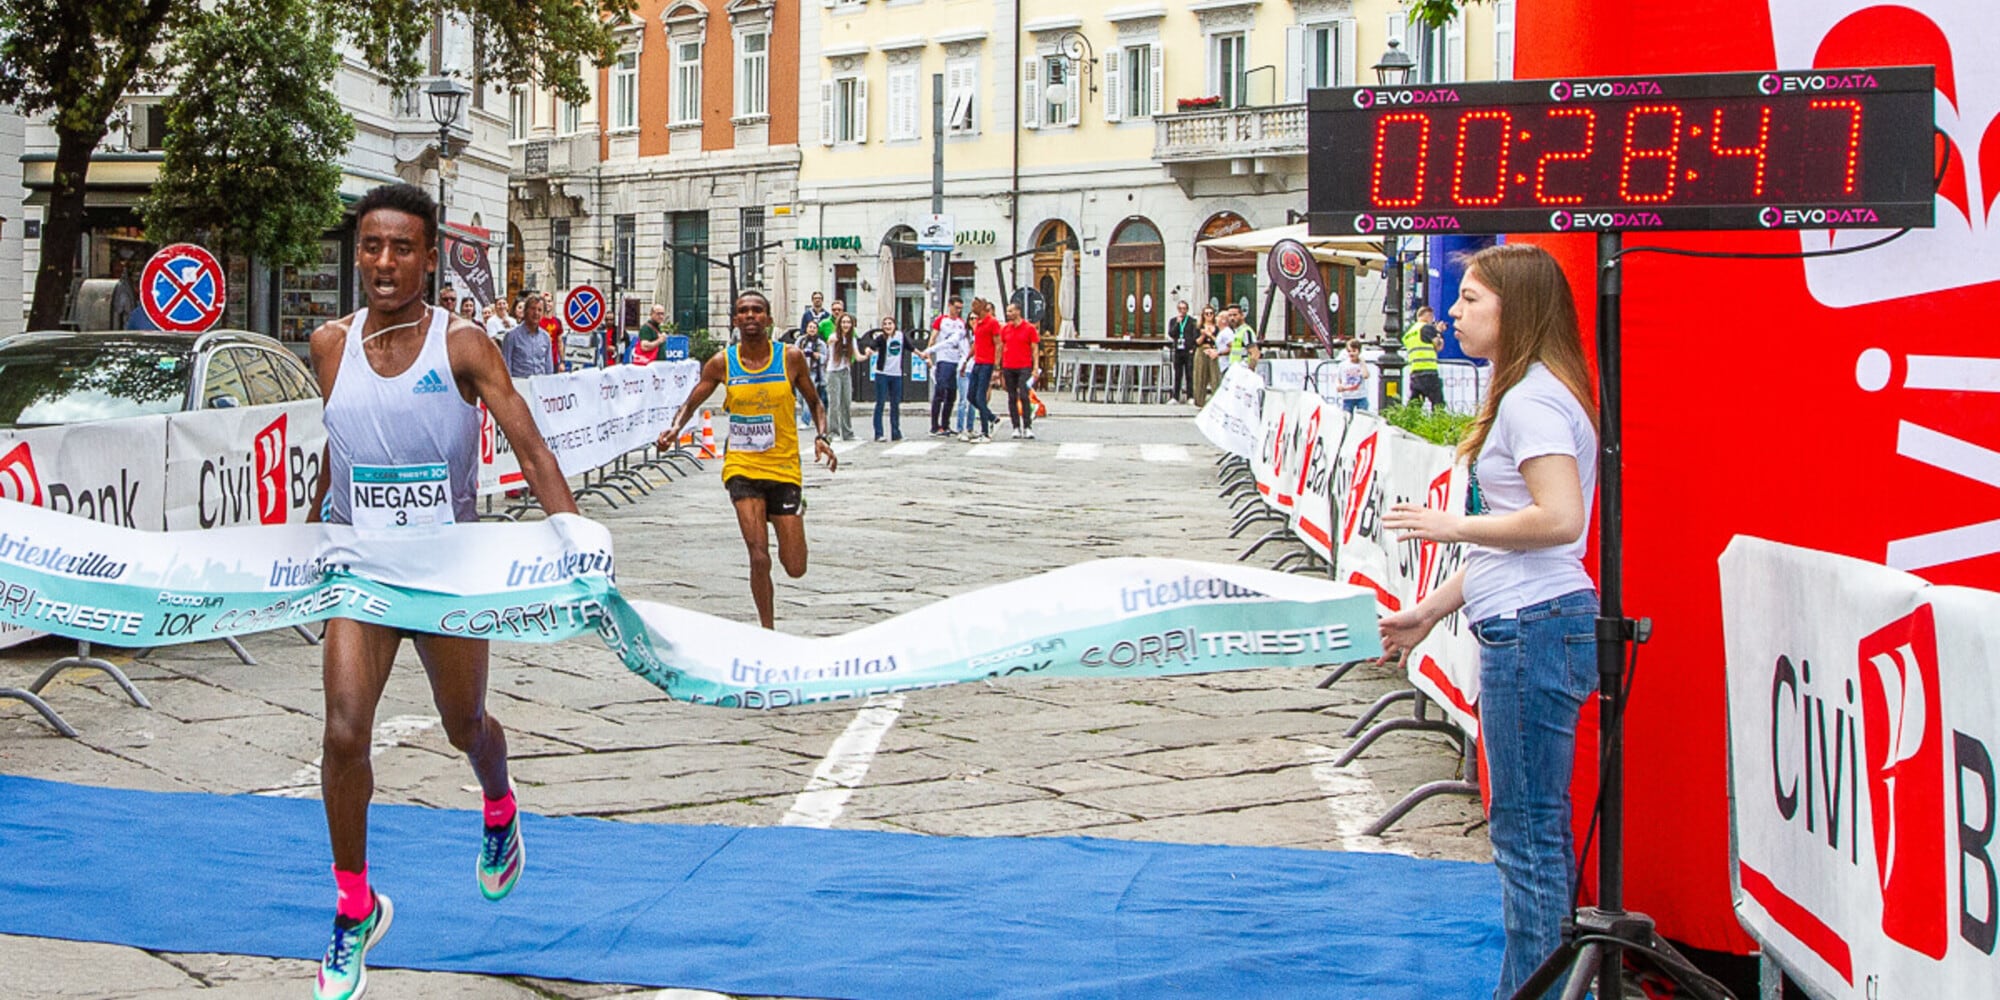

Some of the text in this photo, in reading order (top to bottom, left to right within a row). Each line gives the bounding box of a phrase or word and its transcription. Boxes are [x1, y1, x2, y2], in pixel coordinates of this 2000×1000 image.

[1573, 81, 1663, 97] EVODATA
[1783, 75, 1879, 91] EVODATA
[1375, 89, 1460, 105] EVODATA
[1373, 98, 1863, 208] 00:28:47
[1375, 216, 1461, 230] EVODATA
[1573, 212, 1663, 227] EVODATA
[1783, 208, 1879, 223] EVODATA
[793, 235, 862, 251] TRATTORIA
[199, 446, 320, 529] Civi Ba
[354, 484, 448, 509] NEGASA
[395, 510, 408, 527] 3
[154, 612, 207, 637] 10K
[1771, 653, 1860, 867] Civi
